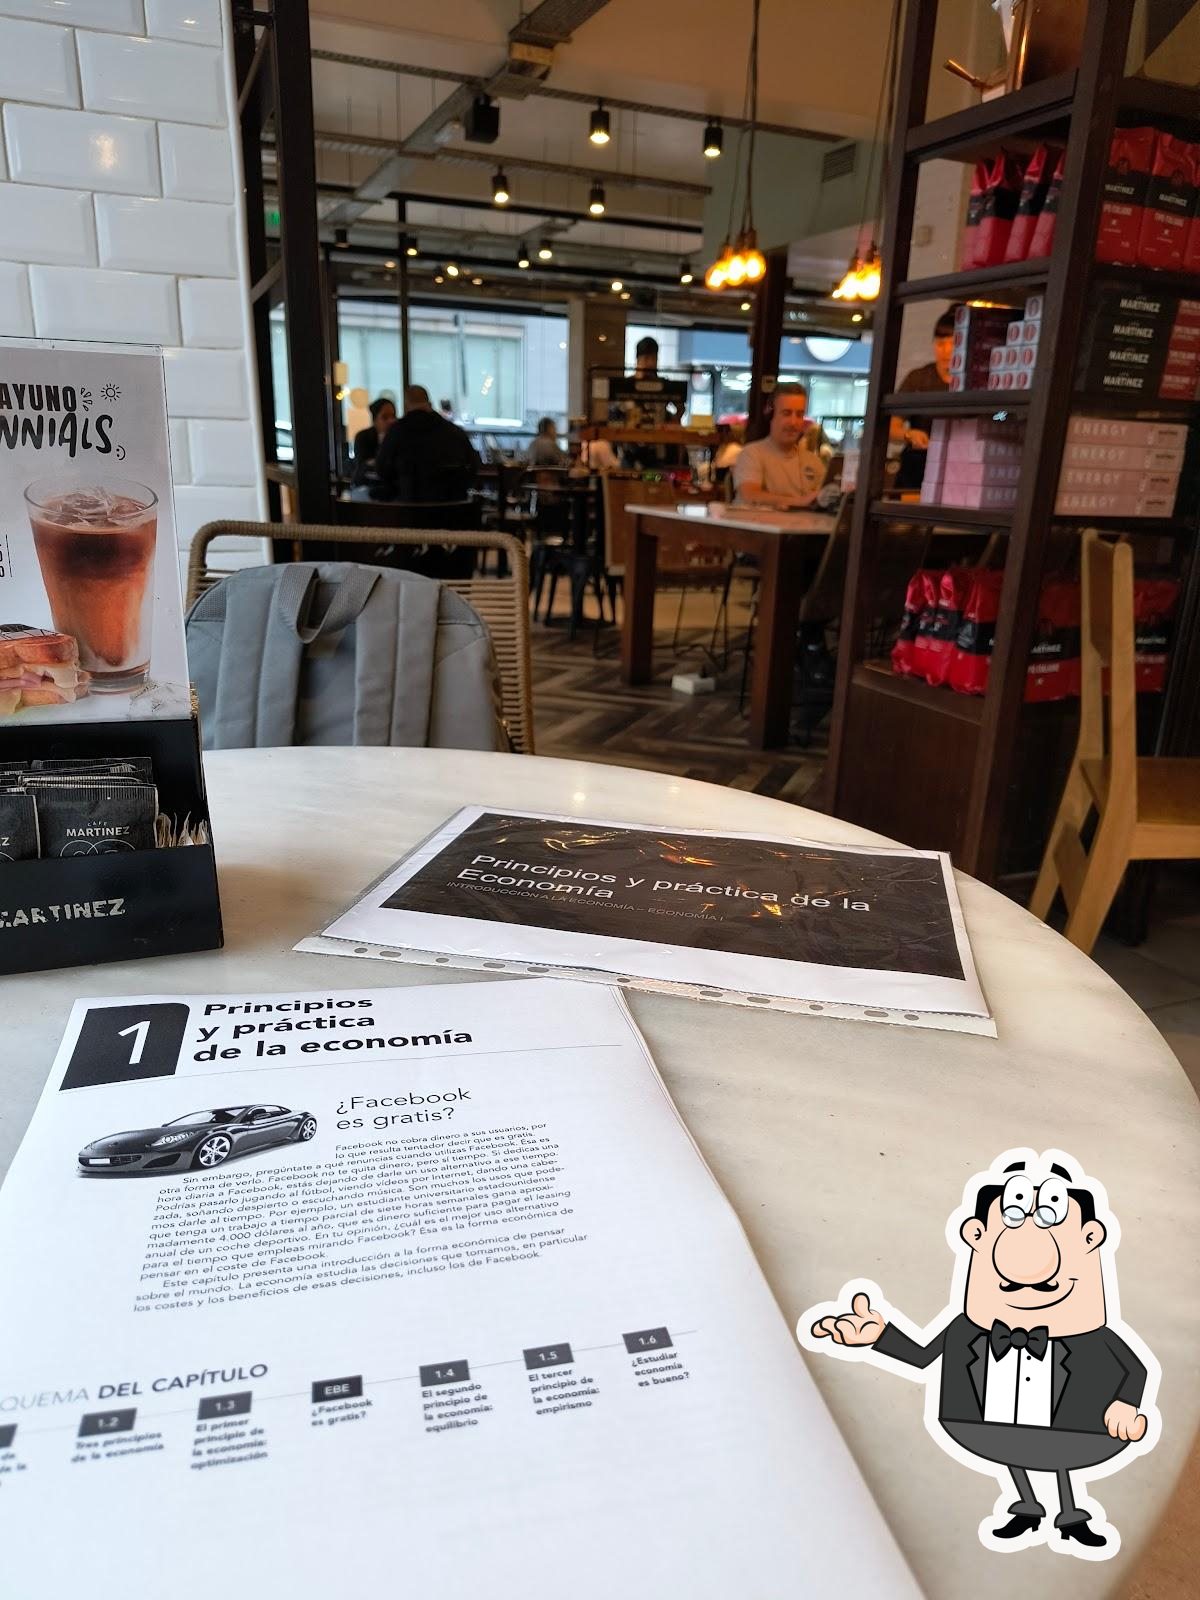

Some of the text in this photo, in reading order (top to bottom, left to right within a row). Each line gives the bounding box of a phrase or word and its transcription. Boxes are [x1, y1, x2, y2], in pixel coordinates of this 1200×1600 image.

[66, 826, 130, 836] MARTINEZ
[446, 882, 539, 898] INTRODUCCIÓN
[457, 868, 614, 898] Economía
[471, 855, 870, 912] Principios y práctica de la
[204, 998, 373, 1016] Principios
[196, 1016, 375, 1042] y práctica
[118, 1020, 150, 1064] 1
[193, 1030, 472, 1062] de la economía
[336, 1088, 472, 1114] ¿Facebook
[336, 1107, 454, 1130] es gratis?
[335, 1140, 382, 1150] Facebook
[488, 1125, 528, 1134] usuarios,
[369, 1146, 400, 1154] resulta
[403, 1142, 444, 1151] tentador
[201, 1172, 252, 1181] embargo,
[255, 1165, 312, 1177] pregúntate
[324, 1160, 343, 1169] qué
[347, 1155, 393, 1165] renuncias
[395, 1151, 431, 1159] cuando
[434, 1147, 466, 1156] utilizas
[268, 1171, 318, 1182] Facebook
[350, 1166, 375, 1174] quita
[416, 1159, 439, 1167] pero
[503, 1146, 539, 1154] dedicas
[147, 1237, 215, 1248] madamente
[254, 1228, 294, 1237] dólares
[337, 1220, 358, 1228] que
[376, 1213, 410, 1222] dinero
[413, 1206, 462, 1216] suficiente
[465, 1202, 488, 1211] para
[491, 1197, 520, 1207] pagar
[536, 1190, 570, 1200] leasing
[191, 1273, 239, 1284] capítulo
[242, 1266, 292, 1280] presenta
[321, 1252, 390, 1267] introducción
[416, 1244, 448, 1253] forma
[451, 1236, 509, 1248] económica
[530, 1228, 564, 1239] pensar
[639, 1336, 656, 1344] 1.6
[539, 1351, 558, 1360] 1.5
[632, 1352, 678, 1367] ¿Estudiar
[436, 1368, 454, 1378] 1.4
[528, 1370, 572, 1382] El tercer
[634, 1362, 682, 1376] economía
[98, 1381, 143, 1399] DEL
[152, 1364, 268, 1392] CAPÍTULO
[652, 1372, 689, 1384] bueno?
[325, 1384, 350, 1394] EBE
[436, 1384, 482, 1396] segundo
[530, 1380, 577, 1394] principio
[312, 1398, 373, 1416] ¿Facebook
[424, 1398, 470, 1410] principio
[532, 1396, 542, 1404] la
[536, 1400, 592, 1414] empirismo
[328, 1410, 366, 1426] gratis?
[424, 1412, 434, 1420] la
[210, 1420, 249, 1431] primer
[426, 1419, 478, 1432] equilibrio
[102, 1432, 162, 1446] principios
[194, 1428, 264, 1445] principio de
